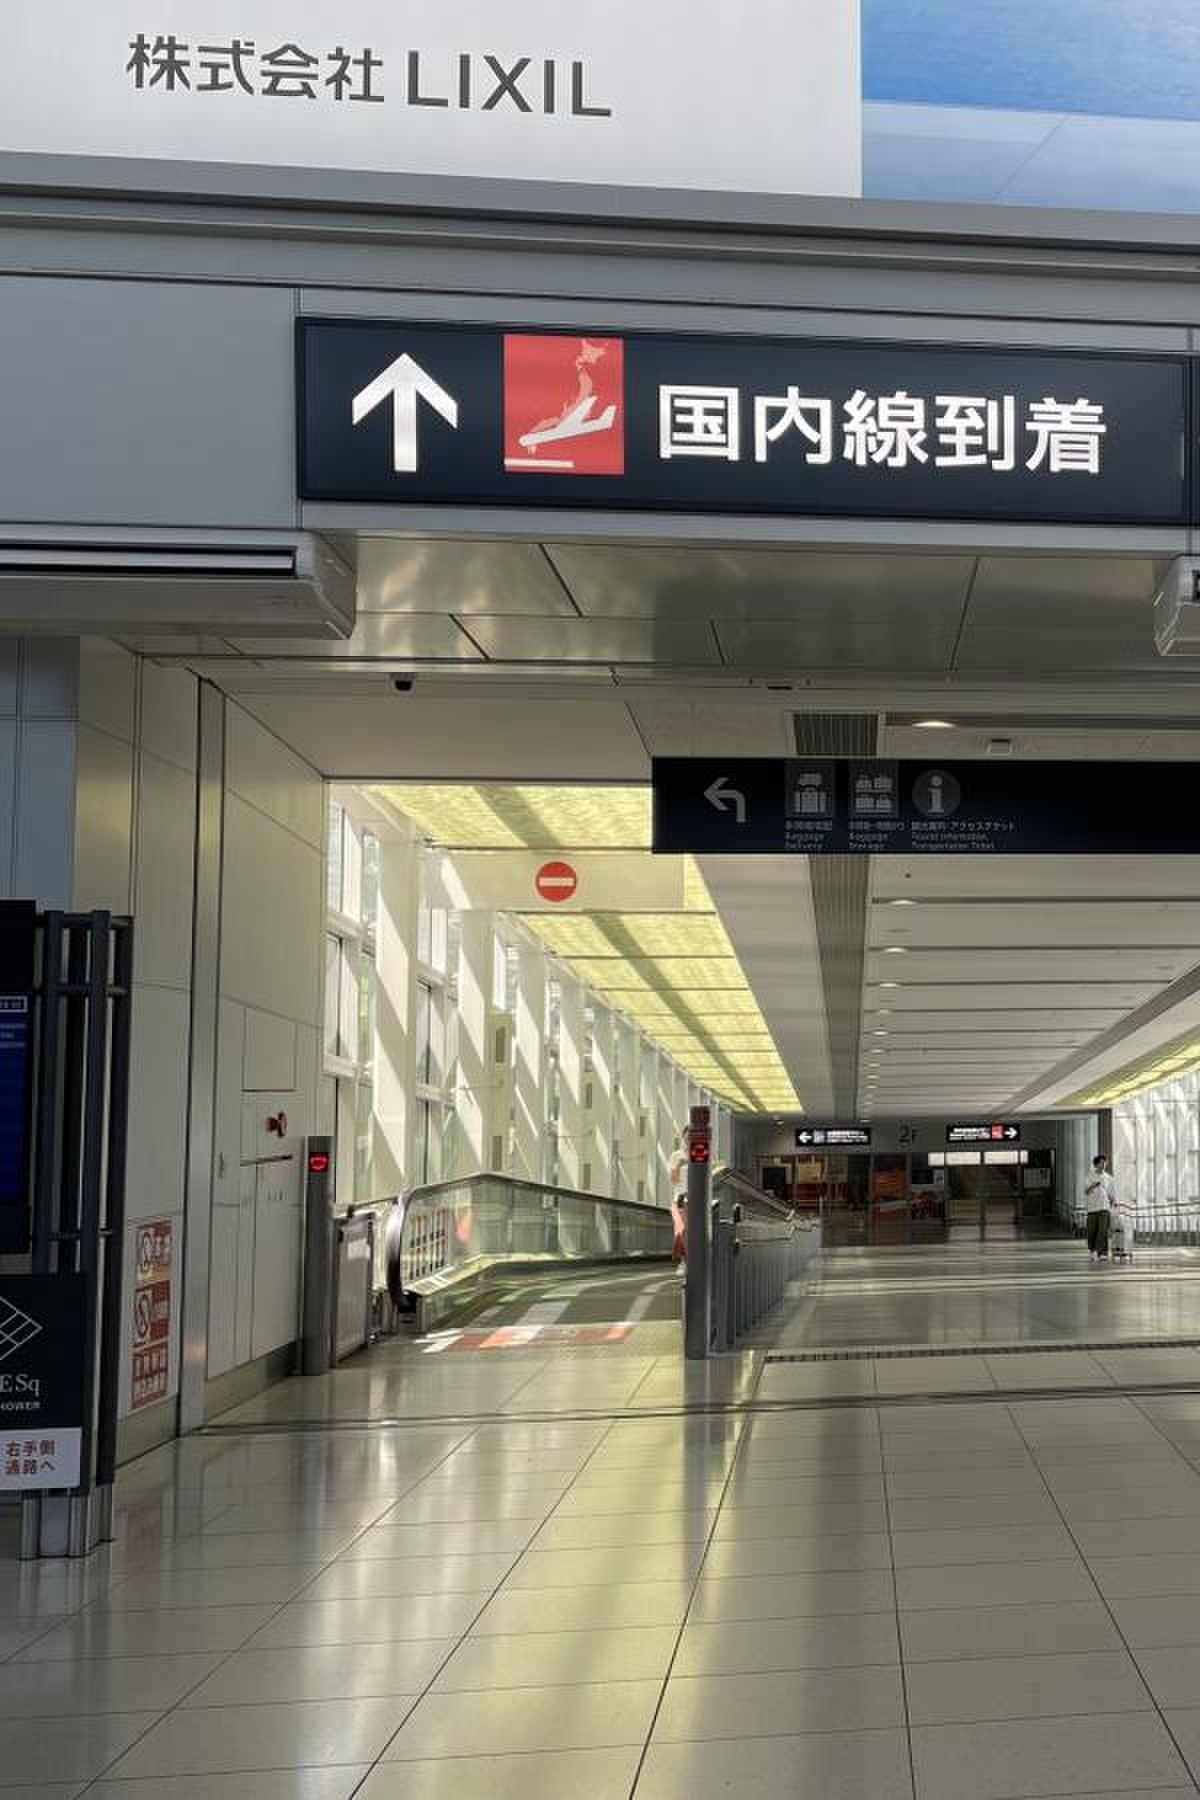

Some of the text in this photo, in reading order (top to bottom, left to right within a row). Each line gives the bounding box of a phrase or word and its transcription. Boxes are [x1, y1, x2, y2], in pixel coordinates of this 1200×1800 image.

[126, 33, 612, 118] 株式会社 LIXIL
[659, 384, 1107, 474] 国内線到着
[5, 1440, 56, 1457] 右手側
[5, 1459, 56, 1475] 通路へ
